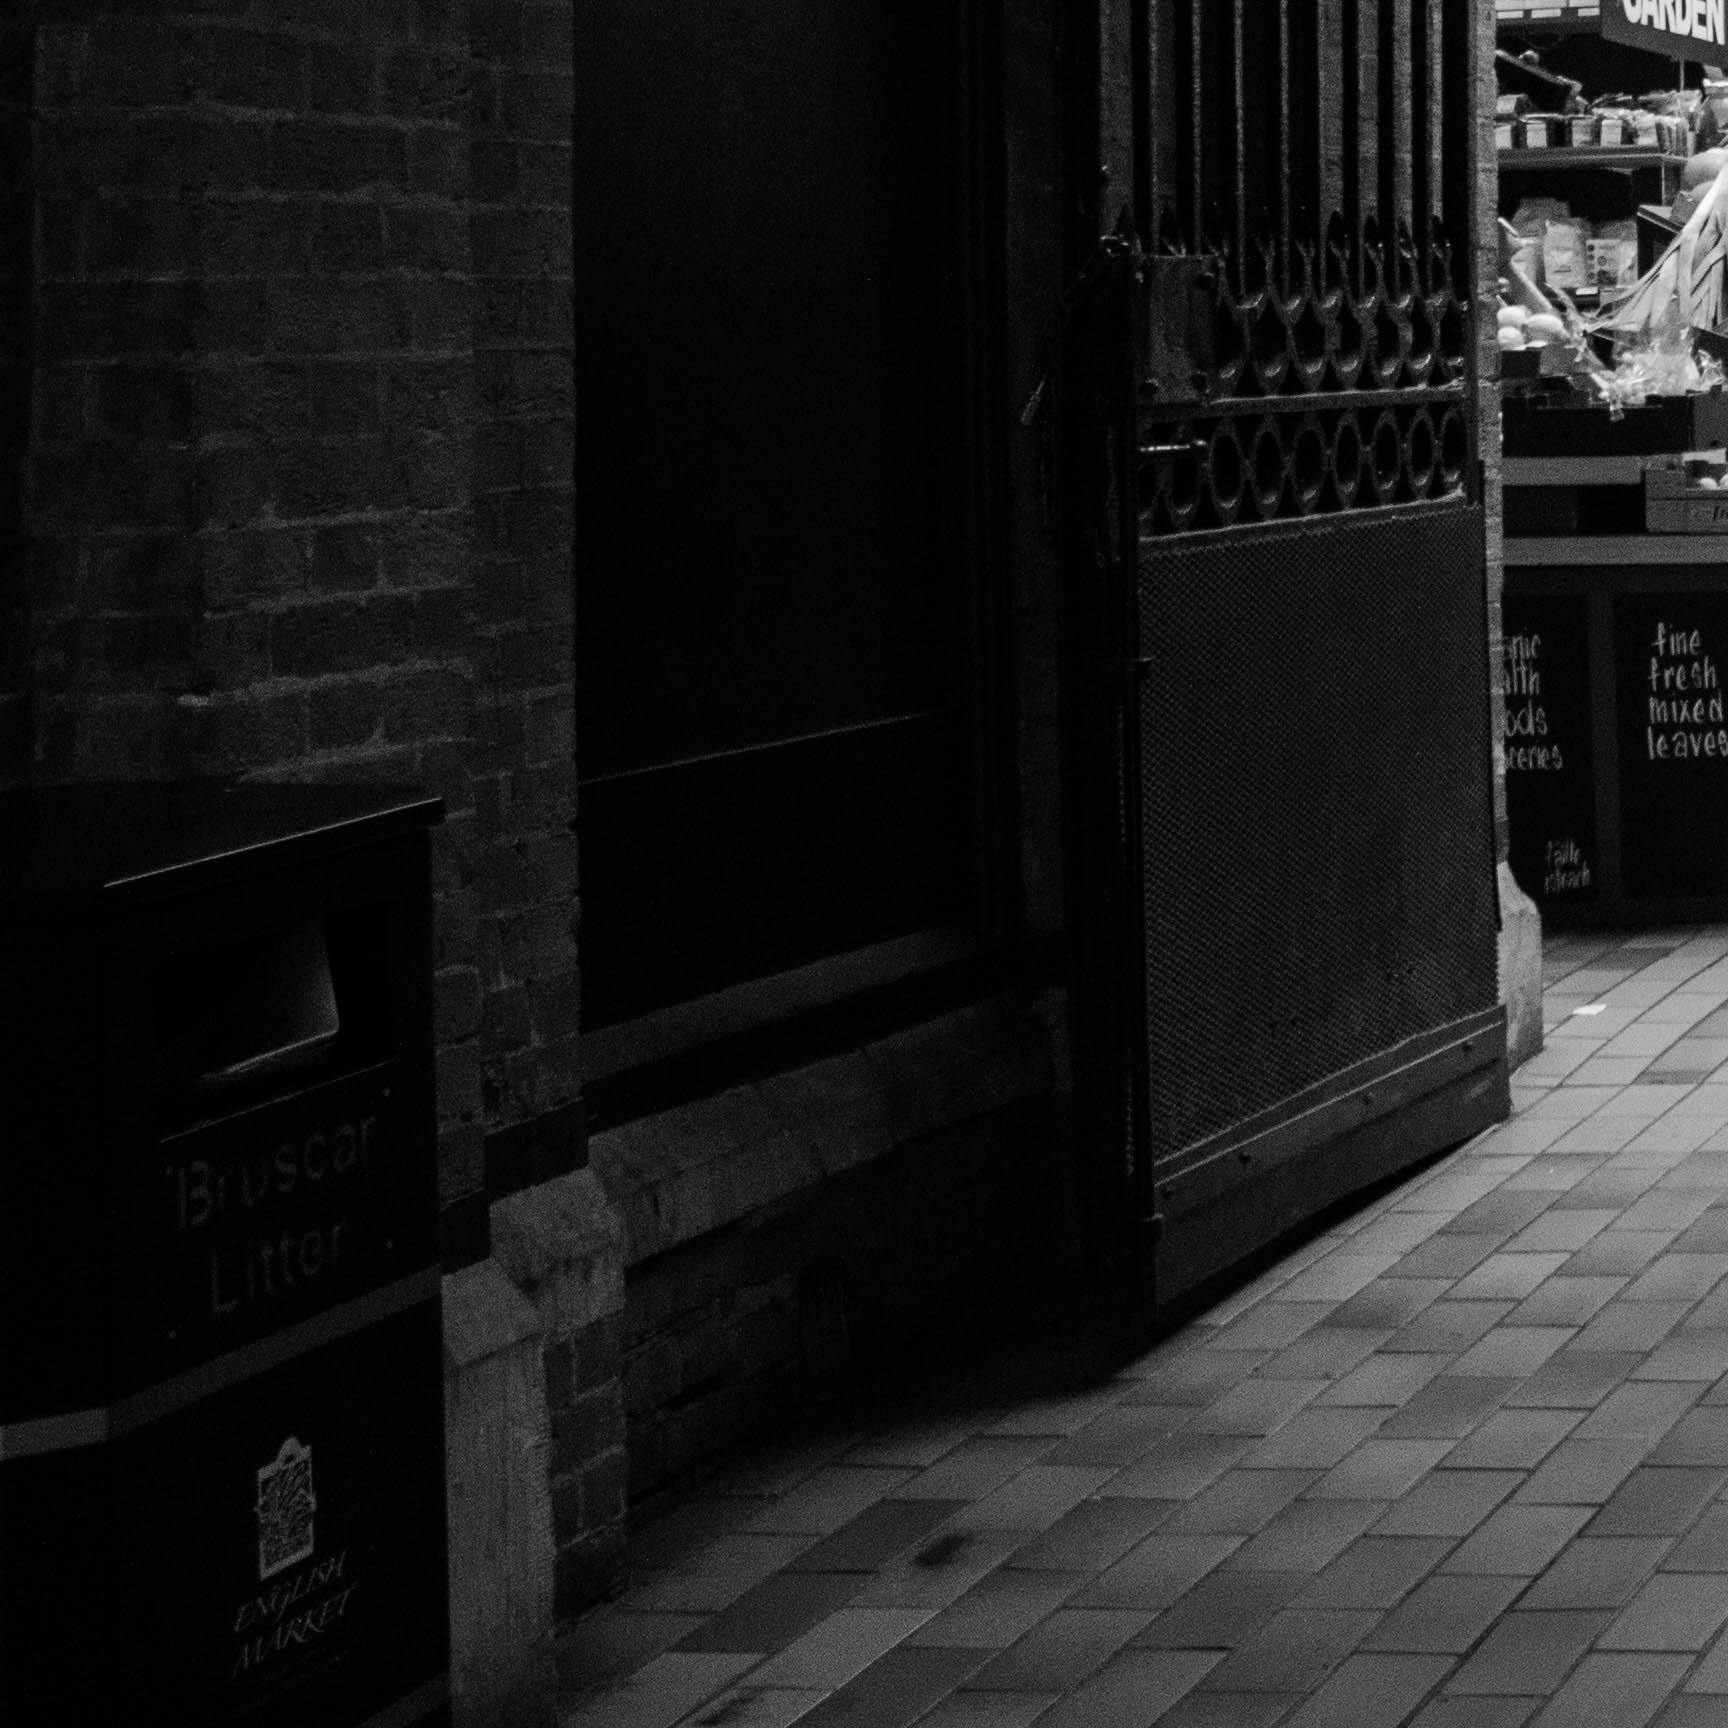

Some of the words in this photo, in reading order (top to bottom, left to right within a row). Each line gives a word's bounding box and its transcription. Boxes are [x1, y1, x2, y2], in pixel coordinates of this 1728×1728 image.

[1649, 655, 1717, 692] fresh
[1652, 622, 1701, 656] fine
[1649, 688, 1724, 723] mixed
[176, 1114, 378, 1232] Bruscar
[207, 1218, 348, 1320] Litter
[232, 1580, 361, 1683] MARKET
